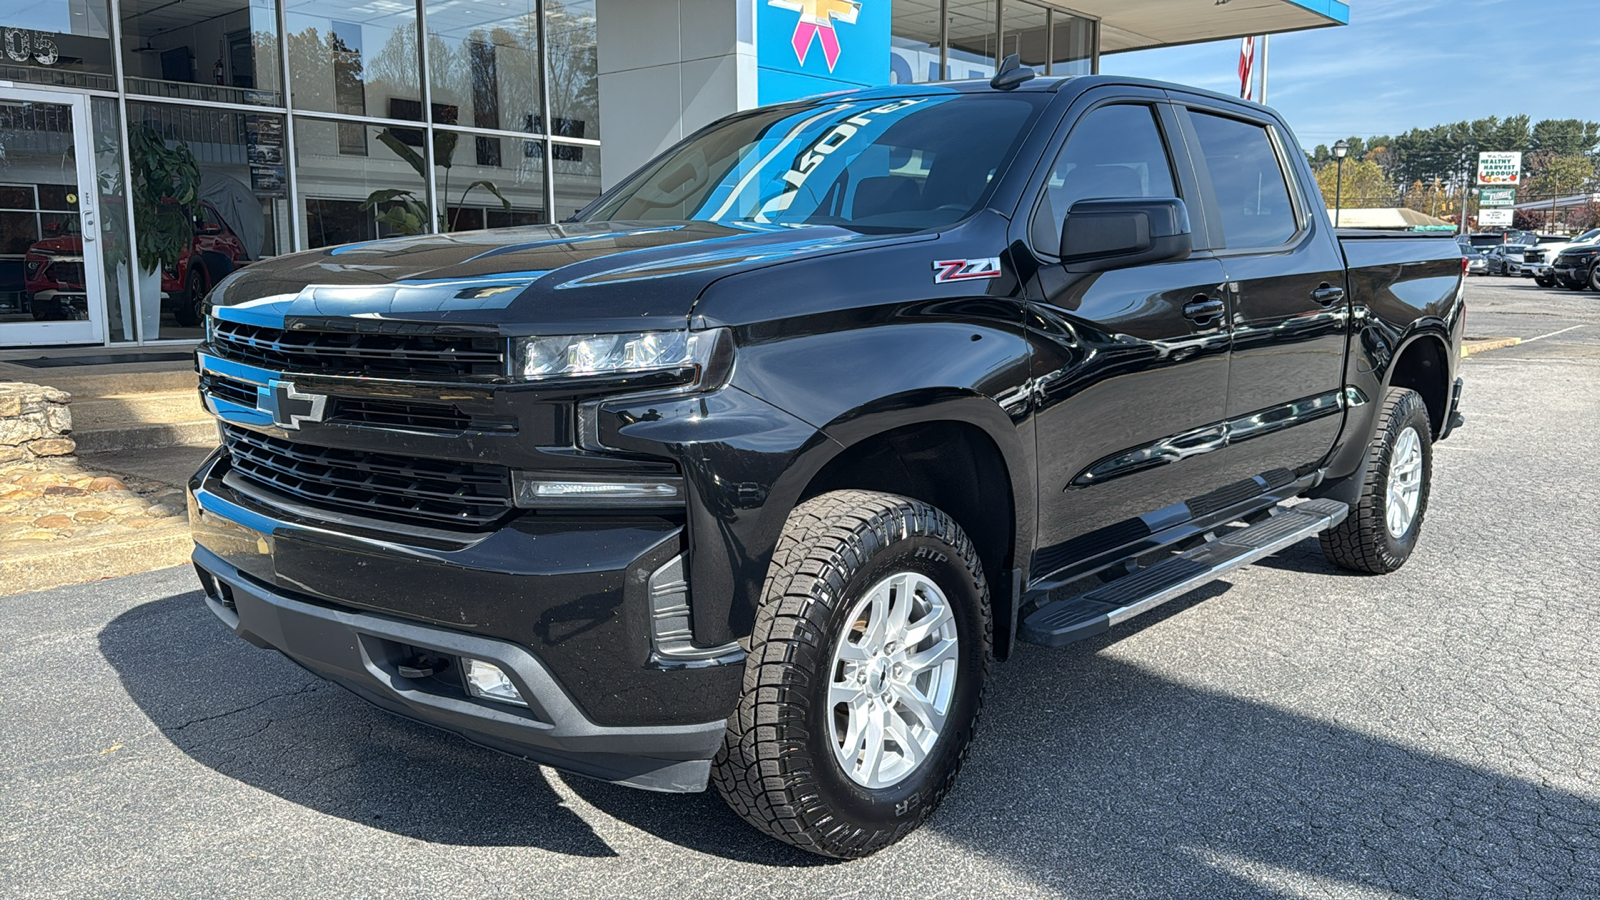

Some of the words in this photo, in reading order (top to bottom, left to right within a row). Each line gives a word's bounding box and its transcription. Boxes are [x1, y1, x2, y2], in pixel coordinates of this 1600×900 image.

[0, 26, 59, 65] 05
[933, 256, 1002, 284] Z71
[914, 546, 947, 564] ATP
